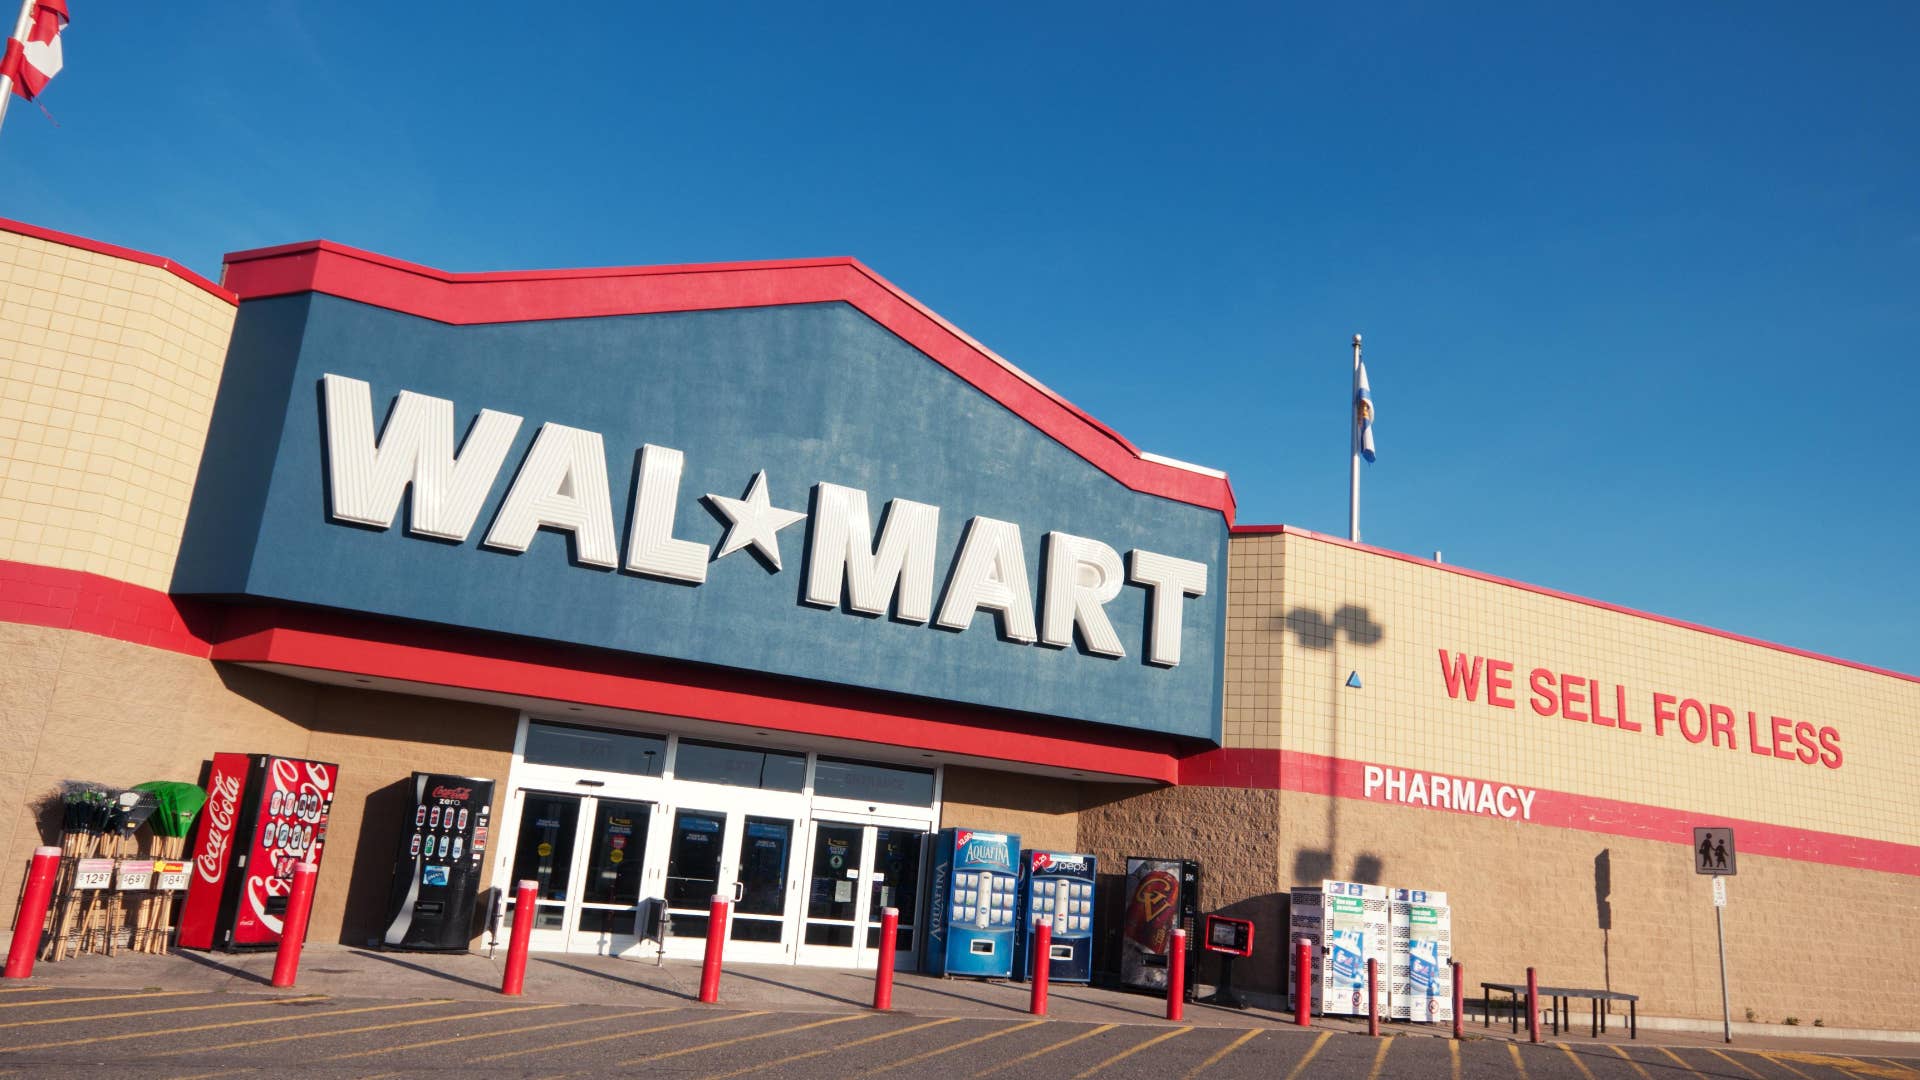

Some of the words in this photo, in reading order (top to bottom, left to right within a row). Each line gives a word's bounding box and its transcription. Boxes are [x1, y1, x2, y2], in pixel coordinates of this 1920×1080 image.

[1438, 648, 1516, 710] WE
[1529, 667, 1642, 733] SELL
[1653, 691, 1738, 751] FOR
[1748, 711, 1844, 770] LESS
[439, 798, 461, 806] zero
[1363, 764, 1537, 820] PHARMACY
[197, 769, 241, 884] Coca-Cola
[965, 842, 1011, 867] AQUAFINA
[1059, 861, 1088, 873] pepsi
